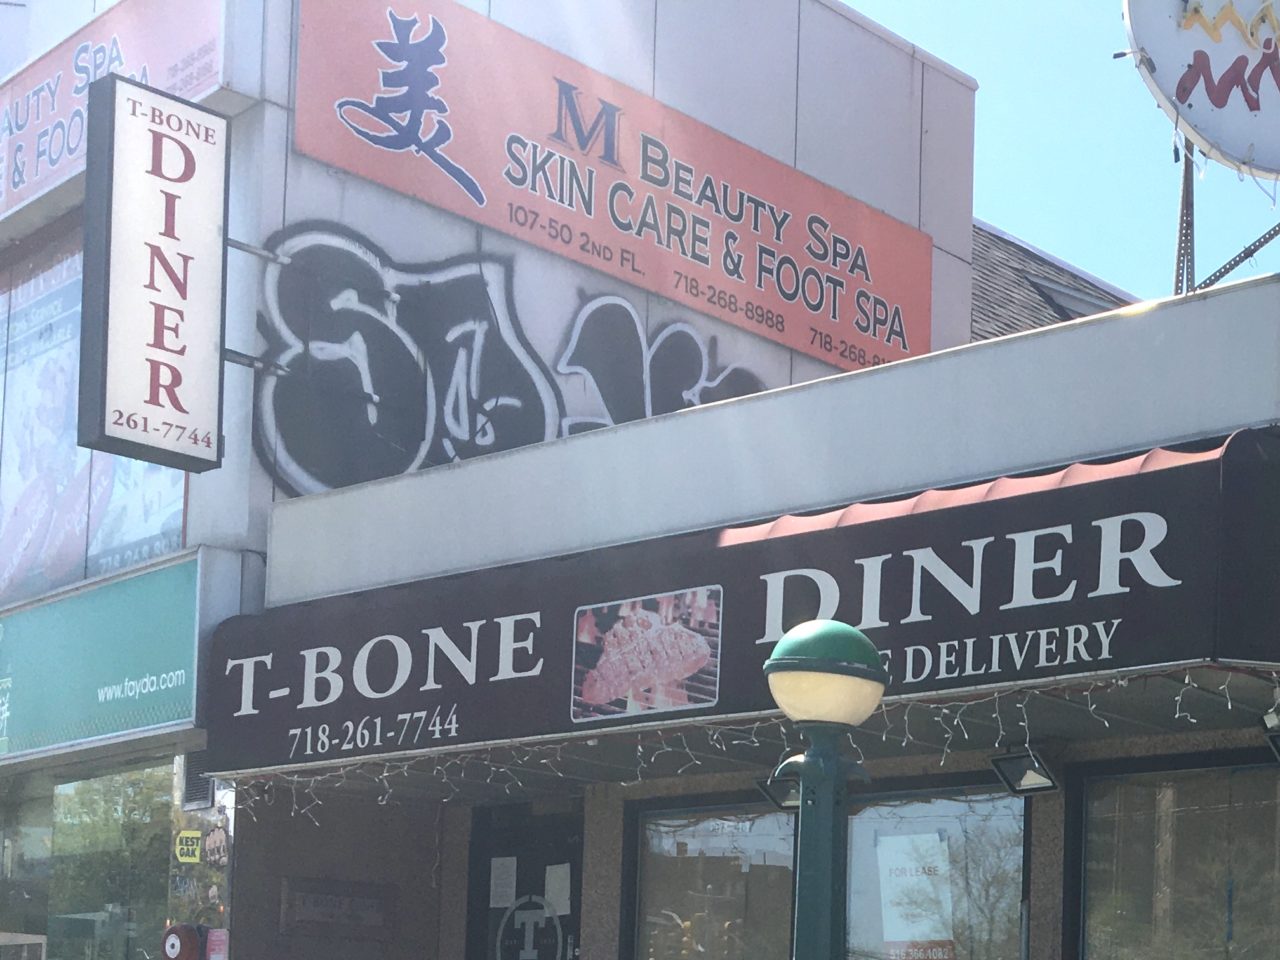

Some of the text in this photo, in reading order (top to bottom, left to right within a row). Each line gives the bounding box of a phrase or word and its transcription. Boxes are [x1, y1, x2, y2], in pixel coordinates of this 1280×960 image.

[73, 34, 124, 96] SPA
[35, 108, 88, 177] FOO
[127, 97, 216, 146] T-BONE
[548, 76, 871, 283] M BEAUTY SPA
[144, 128, 197, 415] DINER
[503, 133, 909, 351] SKIN CARE & FOOT SPA
[507, 202, 573, 245] 107-50
[580, 232, 613, 262] 2ND
[620, 248, 646, 275] FL.
[673, 271, 785, 332] 718-268-8988
[112, 409, 213, 448] 261-7744
[755, 511, 1181, 646] DINER
[225, 611, 544, 717] T-BONE
[903, 618, 1122, 684] DELIVERY
[97, 669, 186, 703] www.fayda.com
[288, 703, 459, 760] 718-261-7744
[889, 866, 939, 878] FOR LEASE
[514, 909, 546, 960] T
